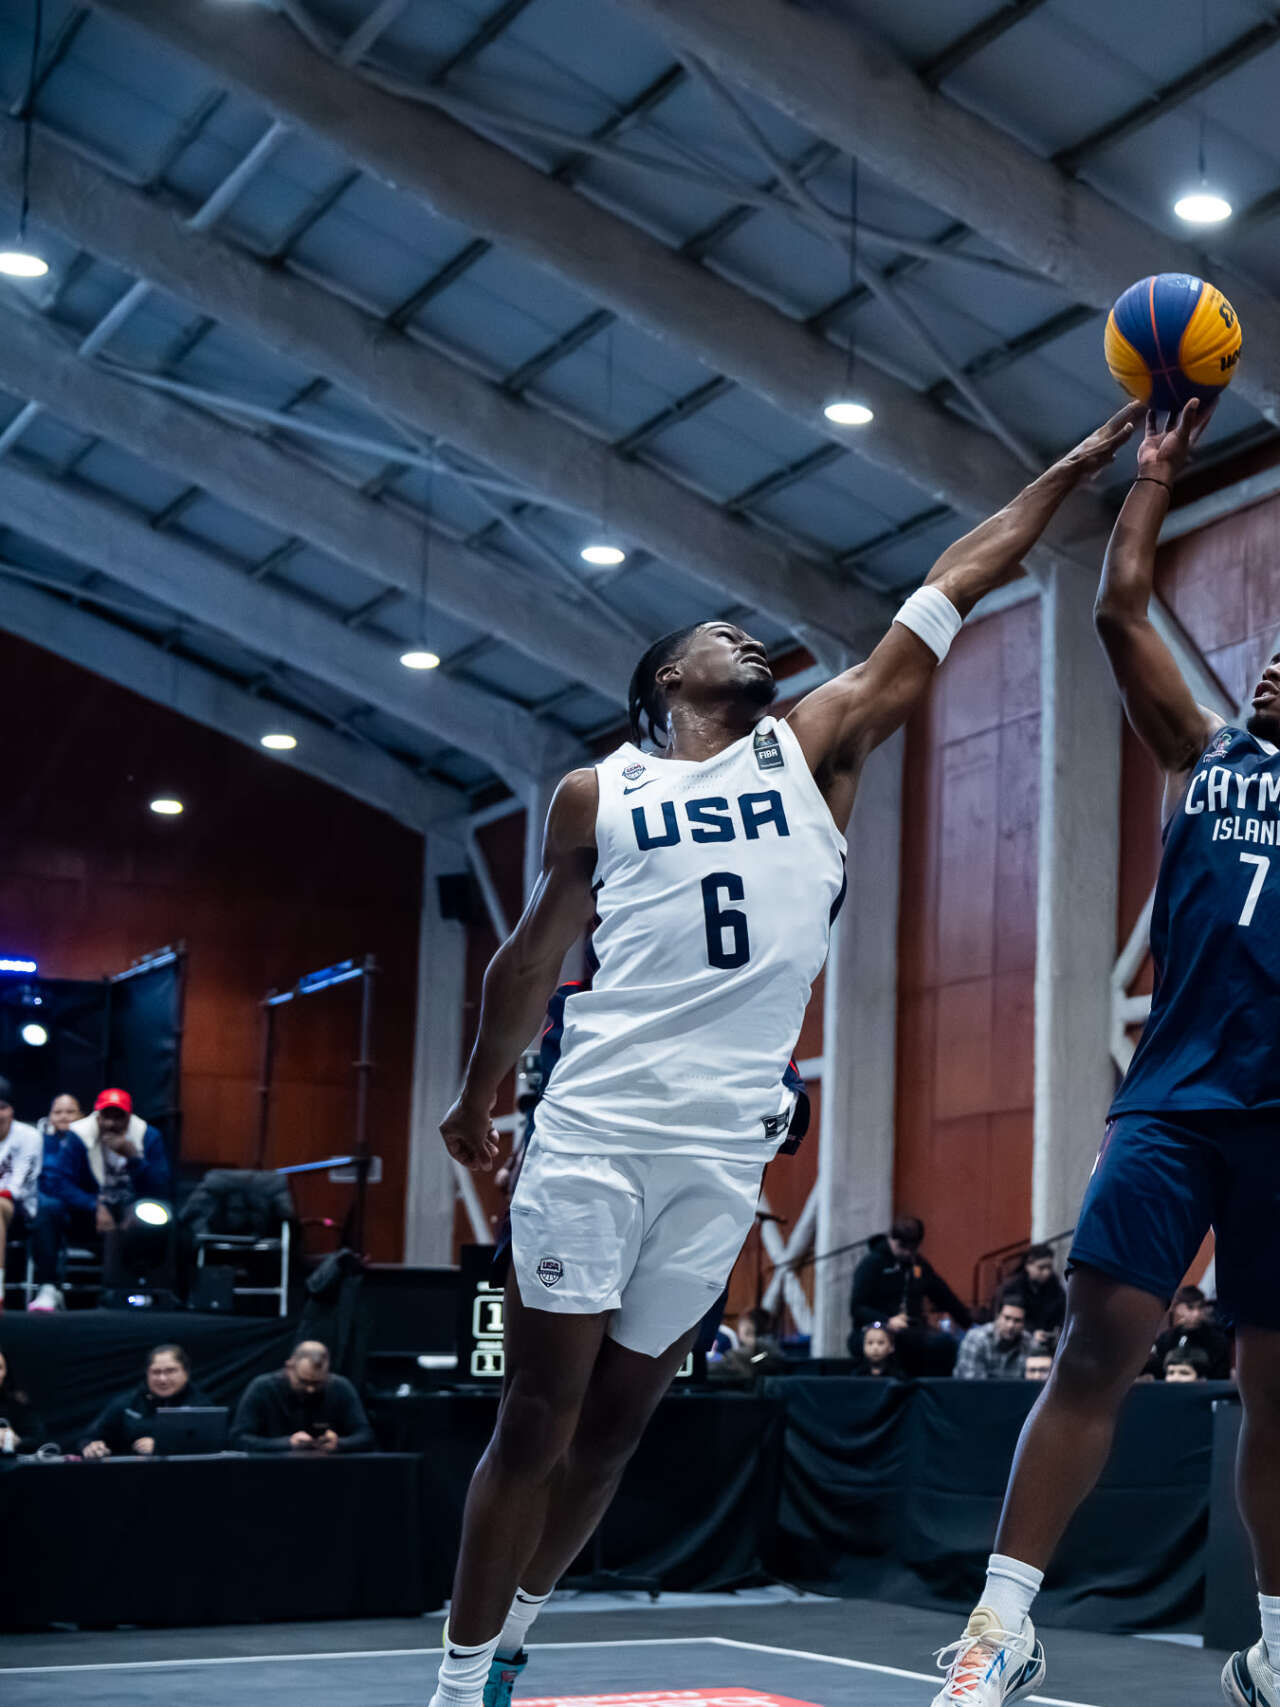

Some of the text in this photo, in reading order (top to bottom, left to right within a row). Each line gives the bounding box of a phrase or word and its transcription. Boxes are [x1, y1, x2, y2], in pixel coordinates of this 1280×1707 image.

[758, 748, 778, 759] FIBA
[631, 789, 790, 851] USA
[701, 871, 750, 970] 6
[1238, 852, 1271, 927] 7
